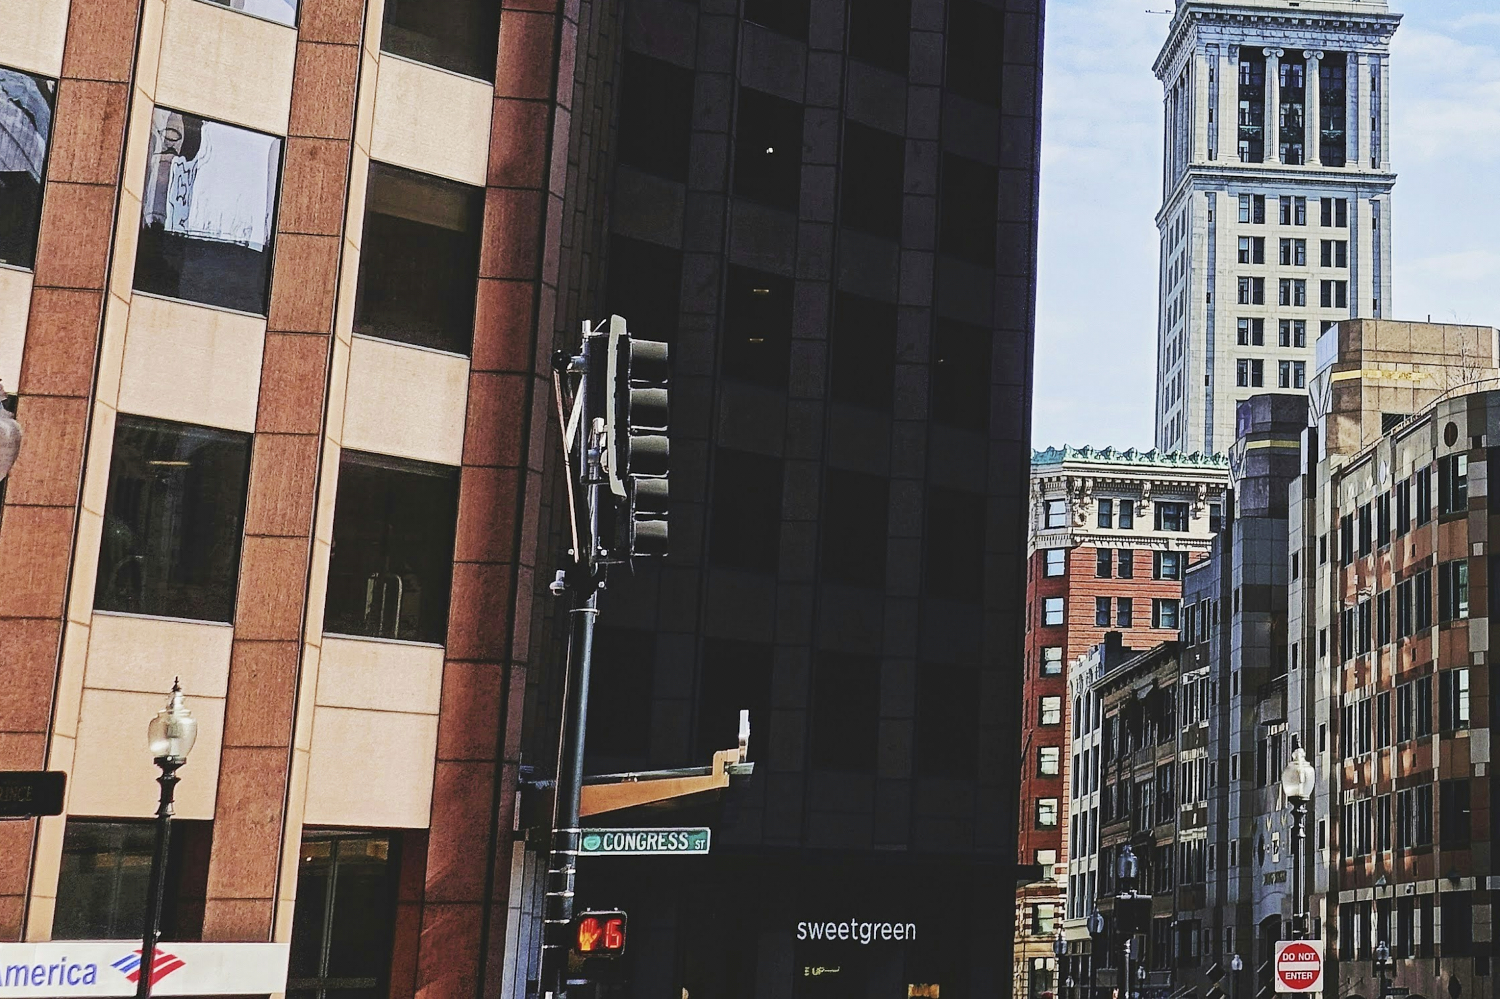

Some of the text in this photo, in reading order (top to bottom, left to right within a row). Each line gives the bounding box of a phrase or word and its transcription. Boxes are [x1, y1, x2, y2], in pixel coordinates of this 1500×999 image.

[603, 832, 706, 851] CONGRESS ST
[796, 918, 916, 945] sweetgreen
[1282, 953, 1316, 961] DO NOT
[0, 956, 98, 987] merica
[1285, 972, 1313, 980] ENTER
